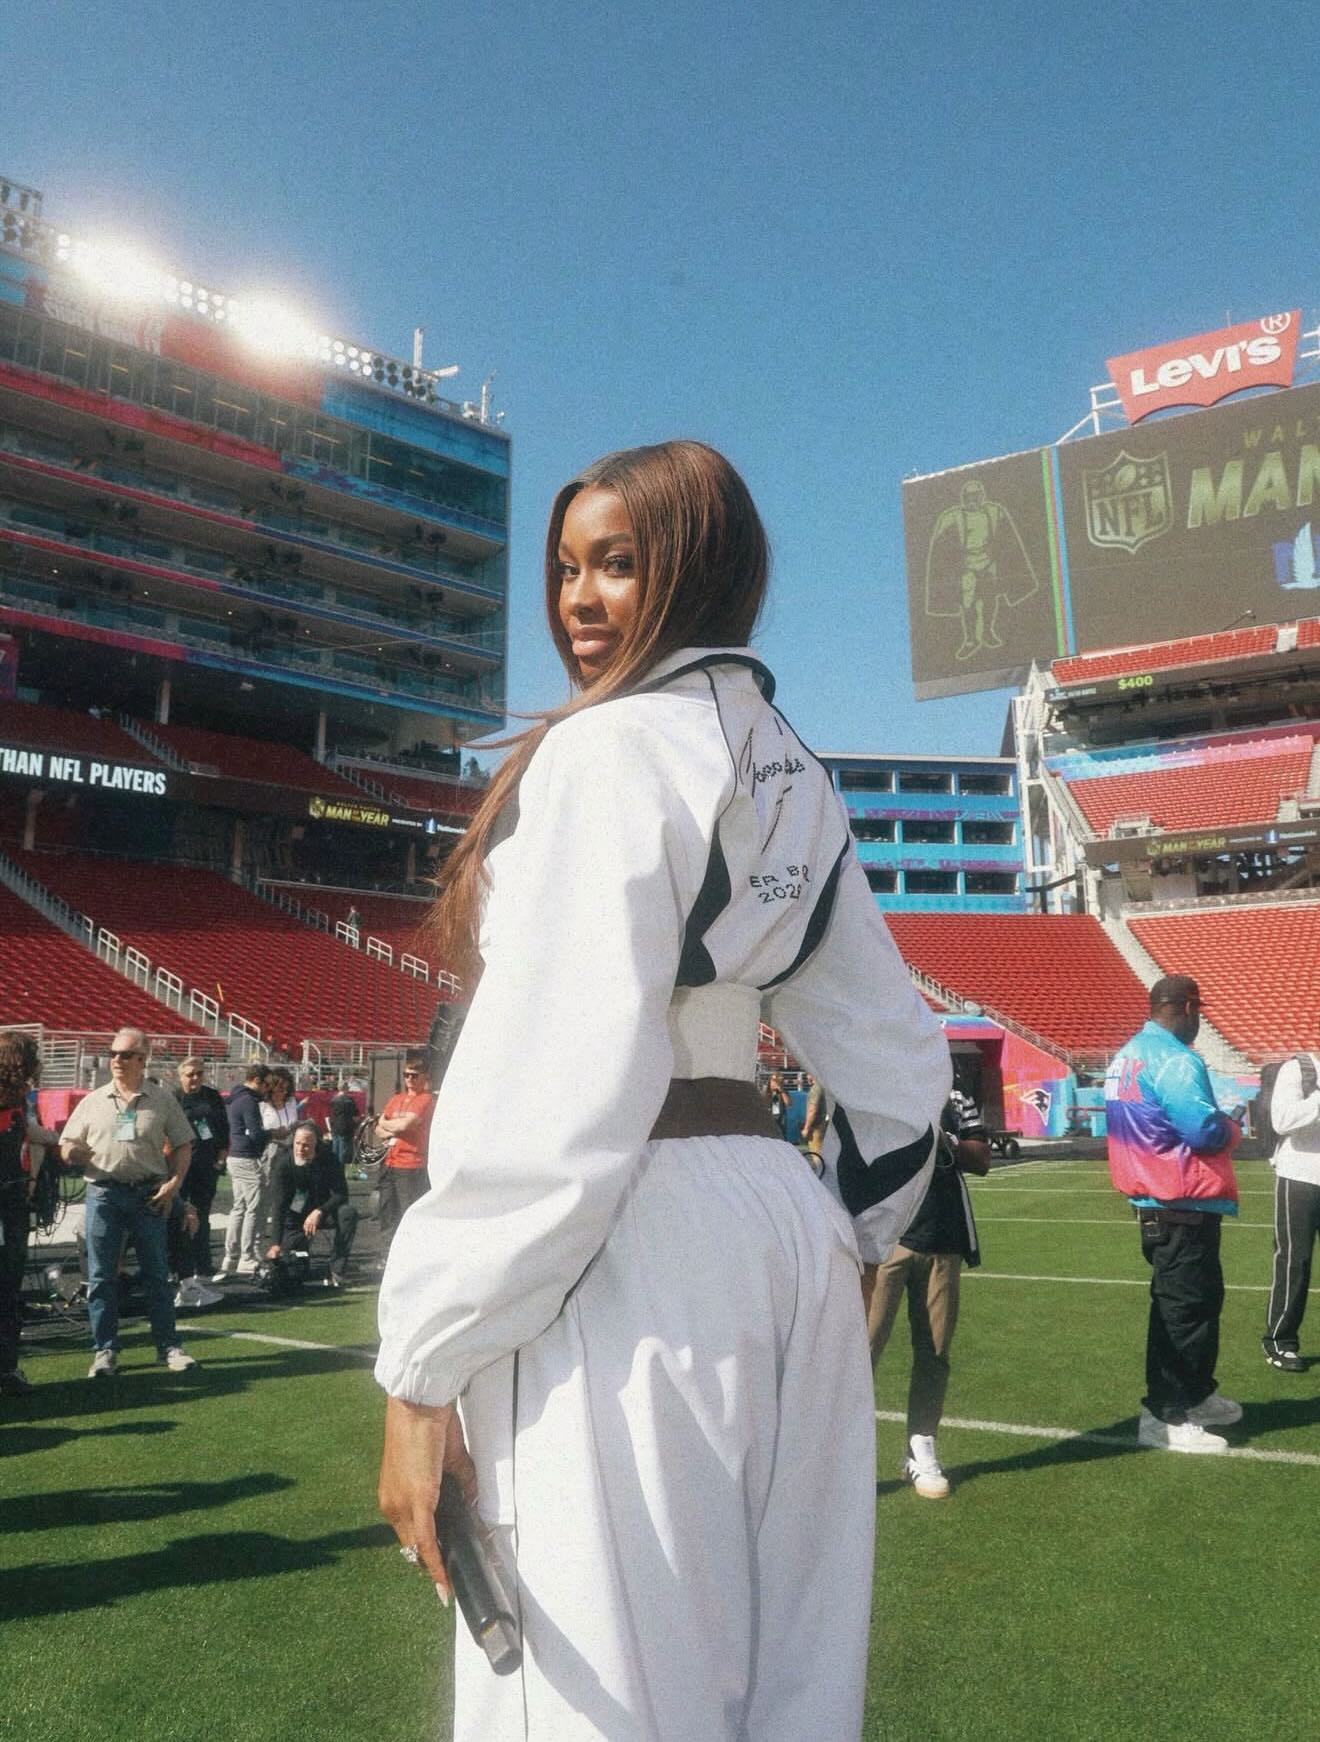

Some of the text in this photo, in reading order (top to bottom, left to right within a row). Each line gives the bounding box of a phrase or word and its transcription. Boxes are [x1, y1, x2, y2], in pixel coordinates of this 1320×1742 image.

[1243, 416, 1320, 448] WAL
[1093, 487, 1166, 541] NFL
[1119, 675, 1153, 690] $400
[49, 756, 84, 783] NFL
[89, 762, 167, 795] PLAYERS
[325, 805, 351, 821] MAN
[361, 810, 390, 827] YEAR
[1162, 841, 1188, 853] MAN
[1197, 837, 1227, 849] YEAR
